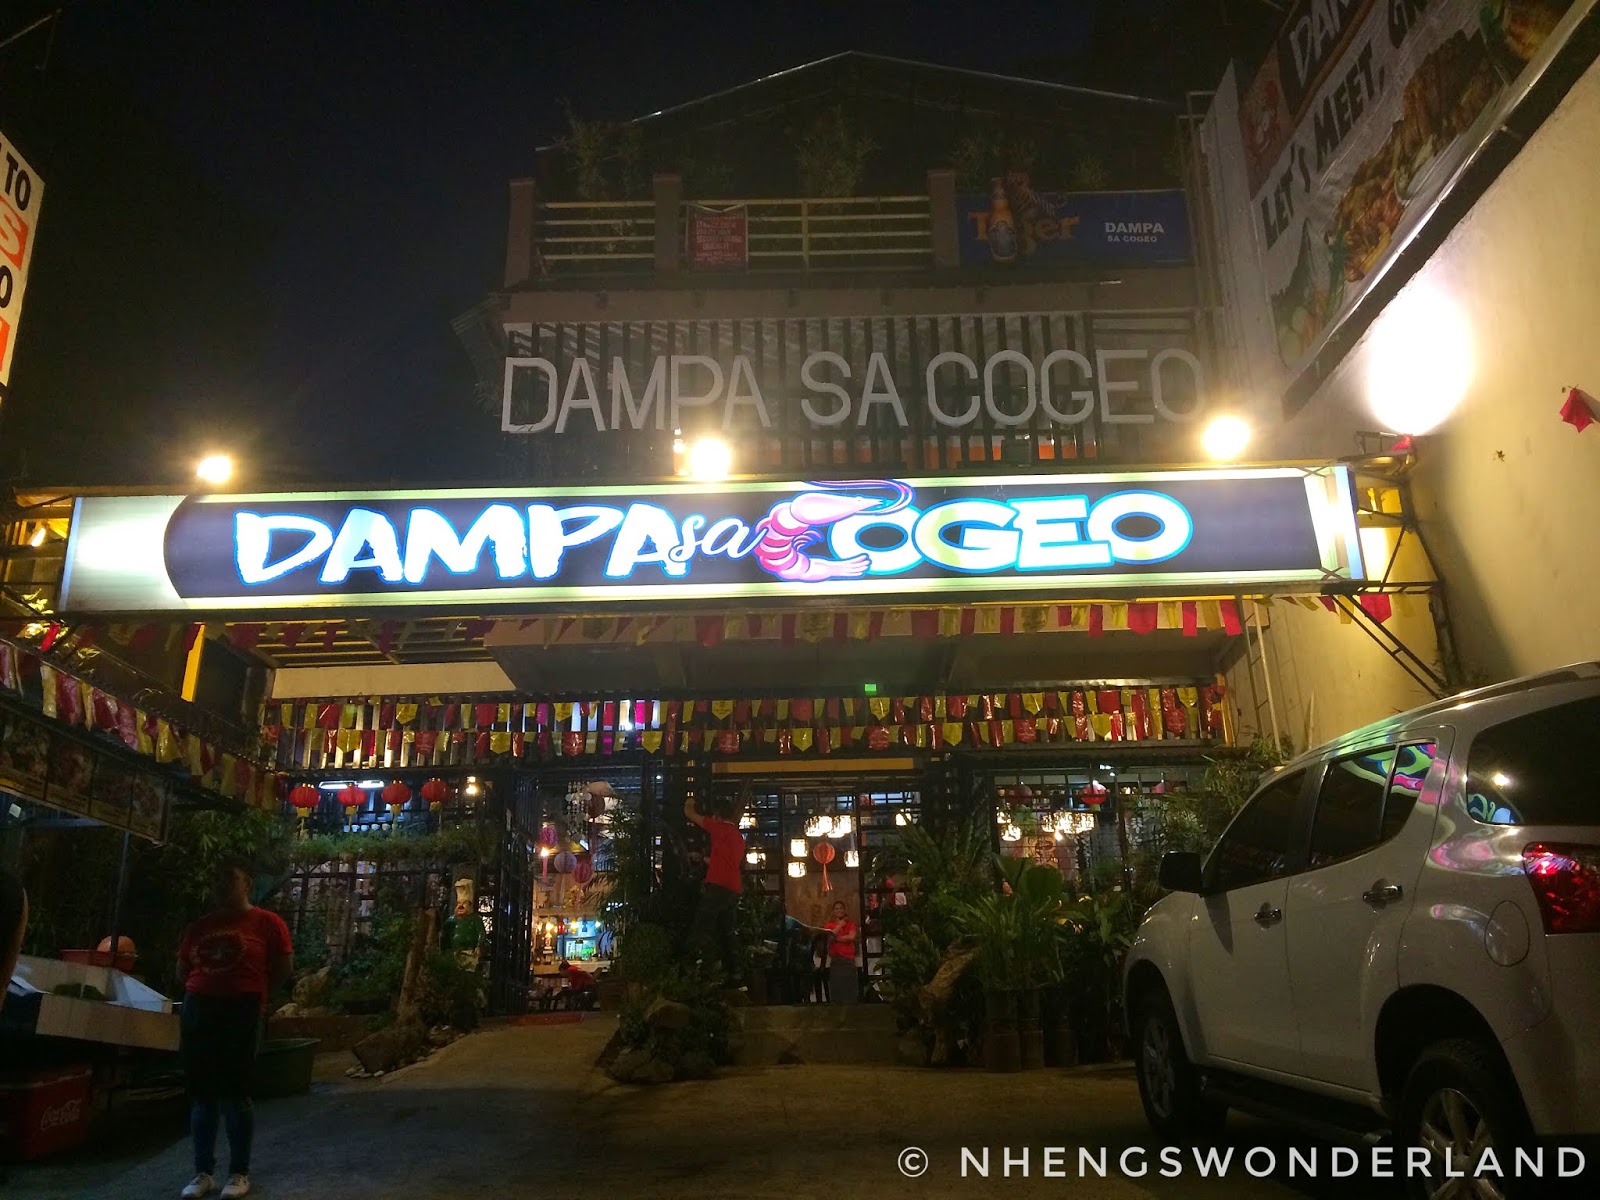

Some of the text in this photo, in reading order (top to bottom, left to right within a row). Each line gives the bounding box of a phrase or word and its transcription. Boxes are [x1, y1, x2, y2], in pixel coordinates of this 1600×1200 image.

[4, 153, 31, 211] TO
[1260, 142, 1311, 252] LET'S
[1104, 221, 1165, 234] DAMPA
[1106, 234, 1158, 243] SA COGEO
[500, 348, 1203, 434] DAMPA SA COGEO
[234, 502, 690, 586] DAMPA
[667, 512, 769, 564] sa
